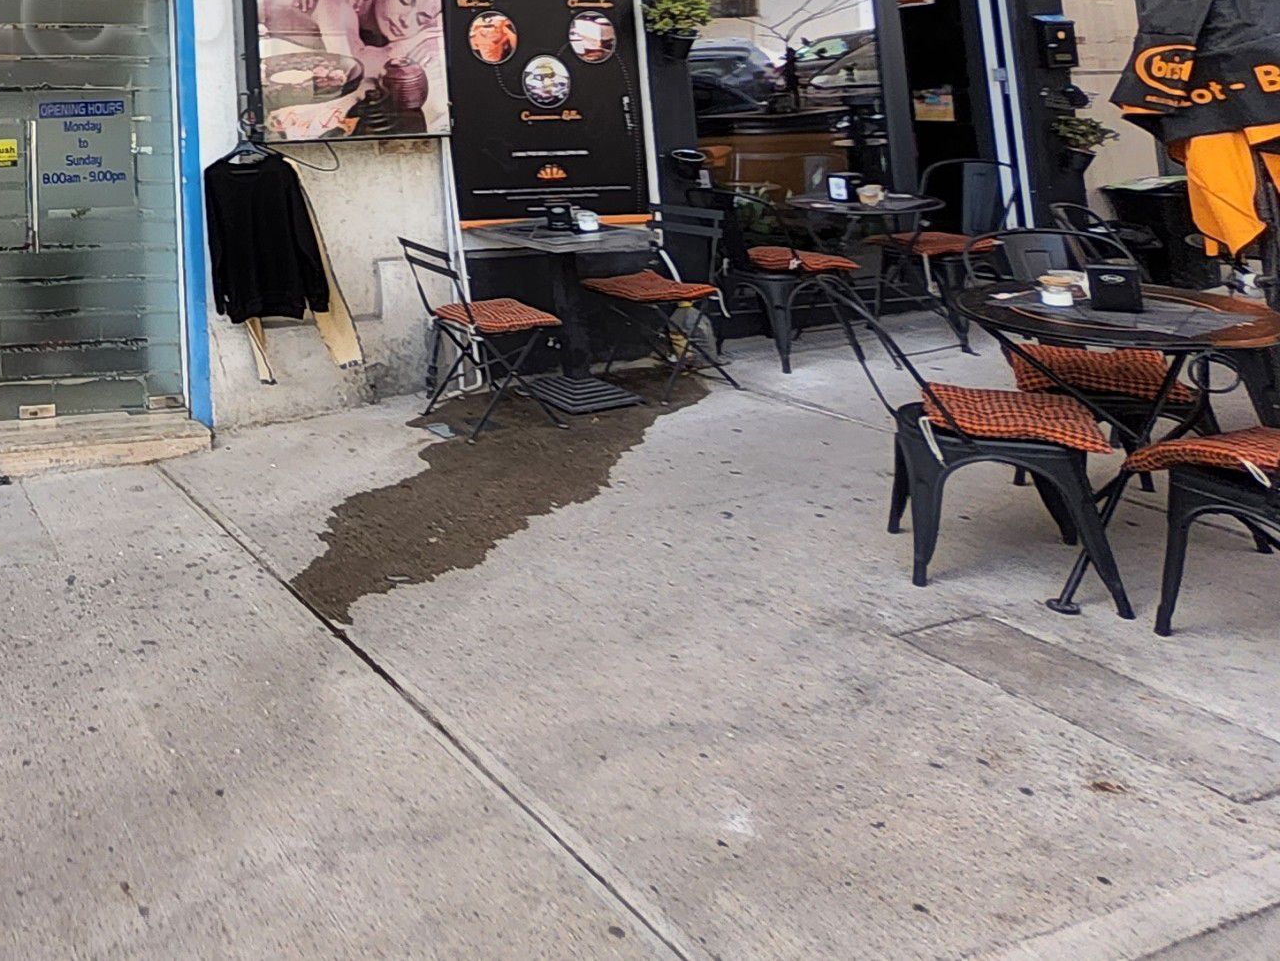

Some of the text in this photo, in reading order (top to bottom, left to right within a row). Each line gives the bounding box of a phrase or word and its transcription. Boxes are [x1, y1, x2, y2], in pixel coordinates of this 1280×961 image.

[40, 101, 123, 116] OPENING HOURS
[64, 121, 102, 133] Monday
[79, 138, 88, 148] to
[65, 154, 103, 167] Sunday
[42, 172, 81, 184] 8.00am
[89, 170, 126, 183] 9.00pm
